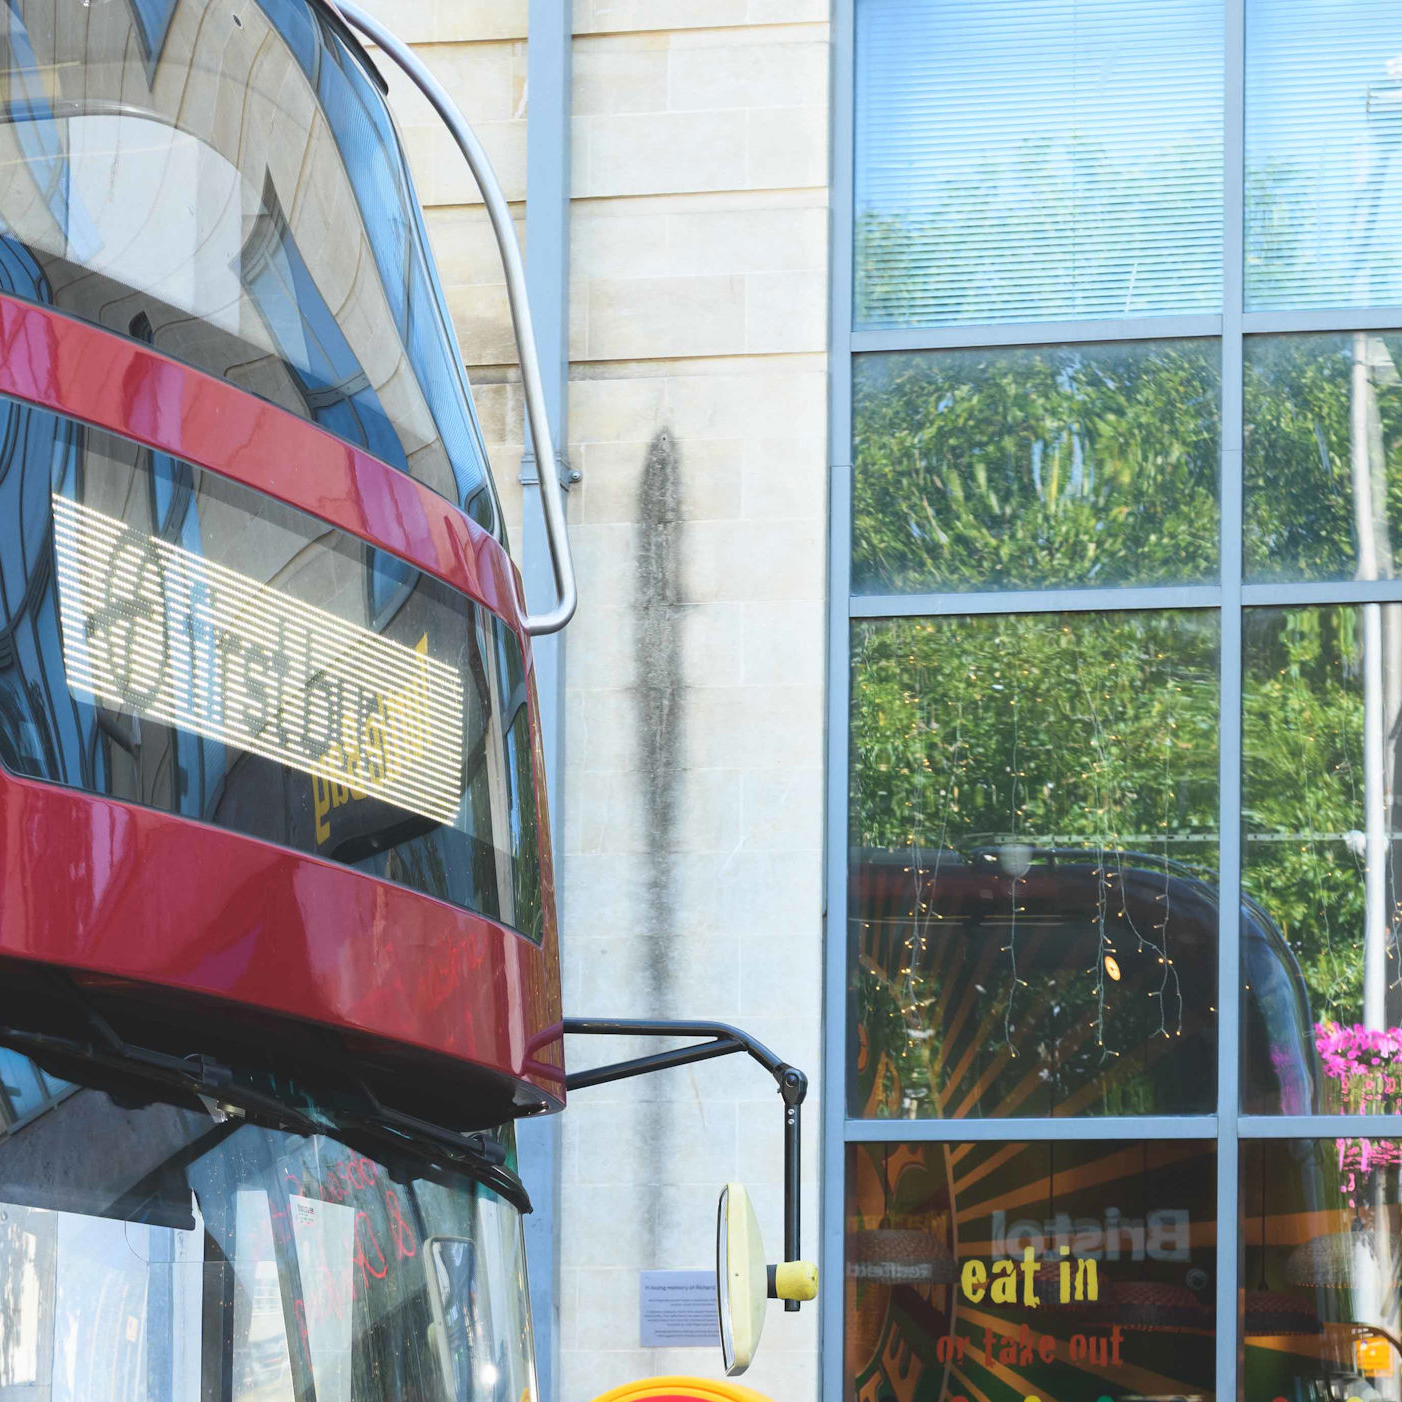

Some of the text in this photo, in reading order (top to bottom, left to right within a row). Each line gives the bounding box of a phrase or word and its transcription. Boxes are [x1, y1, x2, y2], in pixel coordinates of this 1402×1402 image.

[960, 1245, 1099, 1309] eat in
[935, 1323, 1125, 1368] or take out
